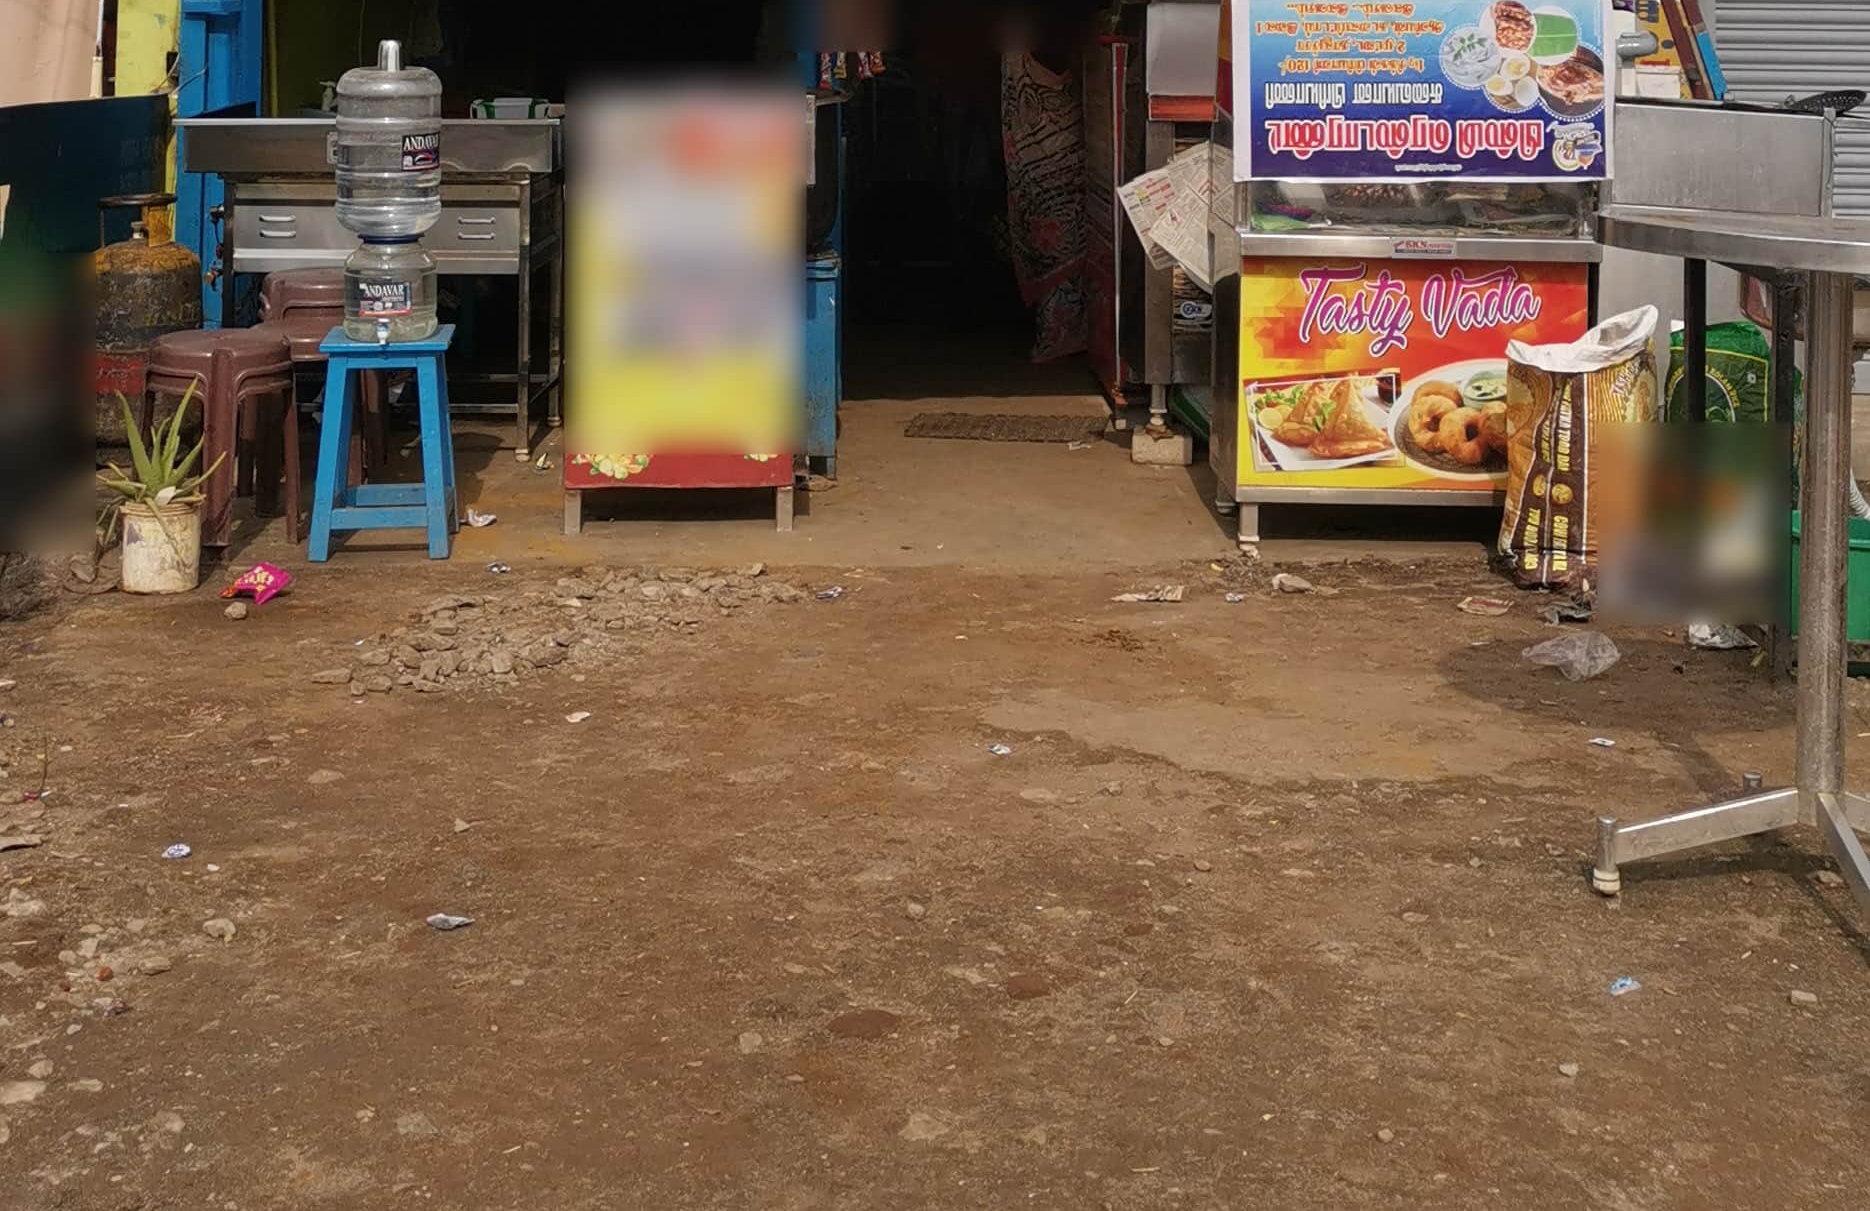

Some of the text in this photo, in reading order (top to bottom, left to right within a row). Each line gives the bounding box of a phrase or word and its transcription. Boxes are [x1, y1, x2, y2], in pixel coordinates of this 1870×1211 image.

[1396, 40, 1406, 53] 2
[1265, 81, 1443, 110] சுவையான பிரியாணி
[1265, 115, 1545, 161] பிஸ்மி ரெஸ்டாரண்ட்
[1299, 261, 1542, 357] Tasty Vada
